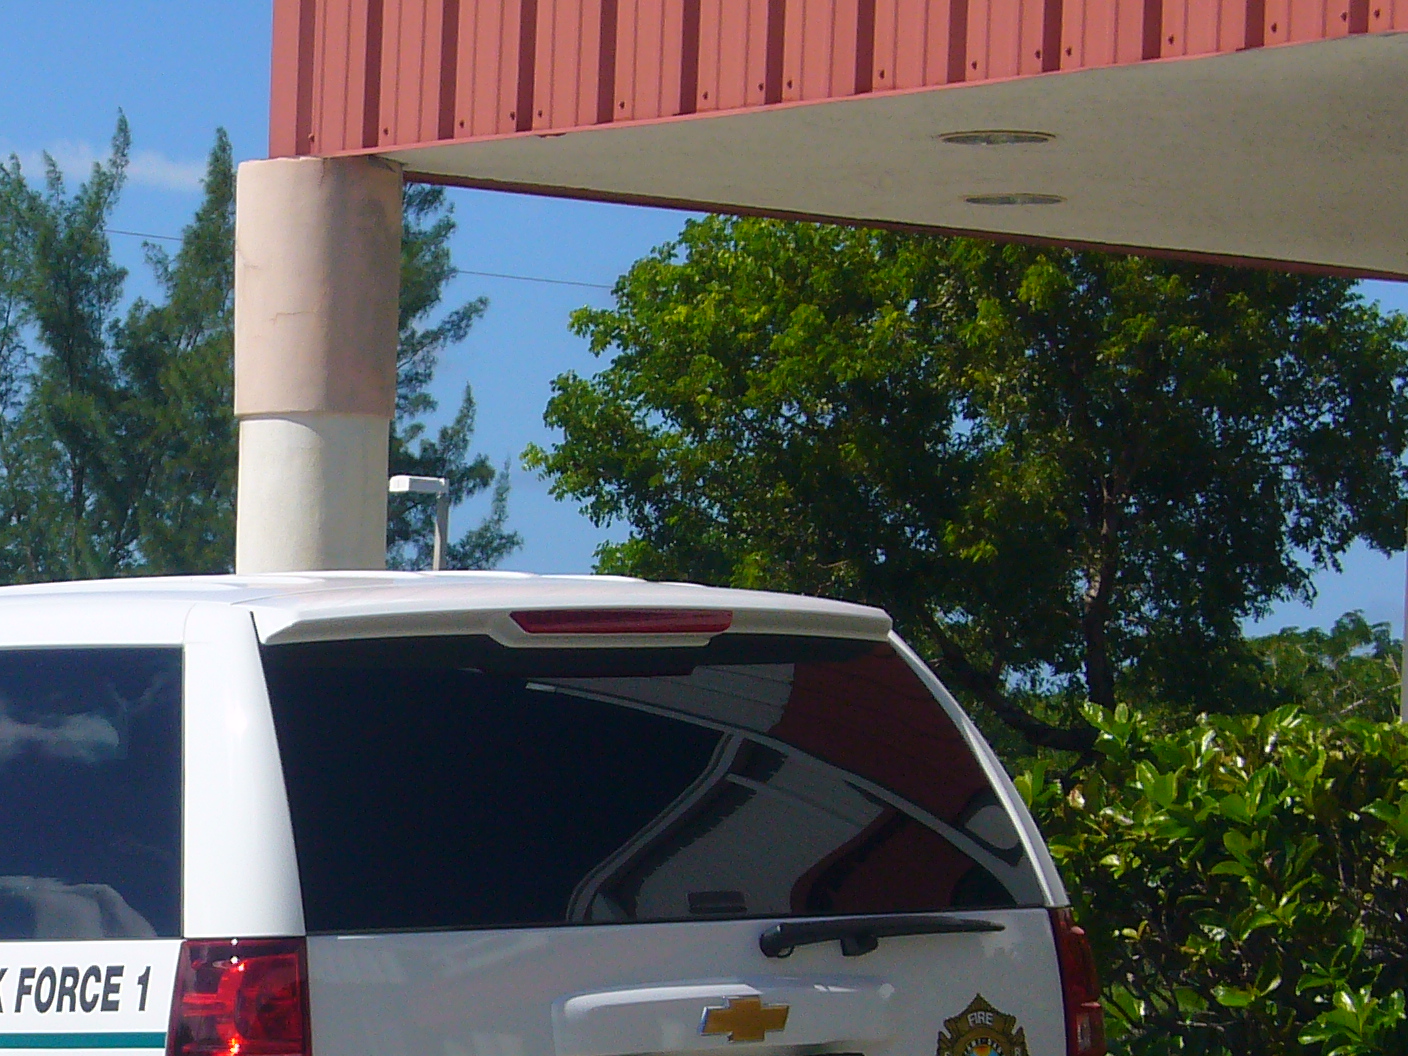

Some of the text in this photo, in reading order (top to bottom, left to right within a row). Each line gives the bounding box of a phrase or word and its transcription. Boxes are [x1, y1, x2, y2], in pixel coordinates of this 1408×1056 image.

[14, 965, 125, 1013] FORCE
[137, 965, 151, 1012] 1
[967, 1011, 994, 1027] FIRE
